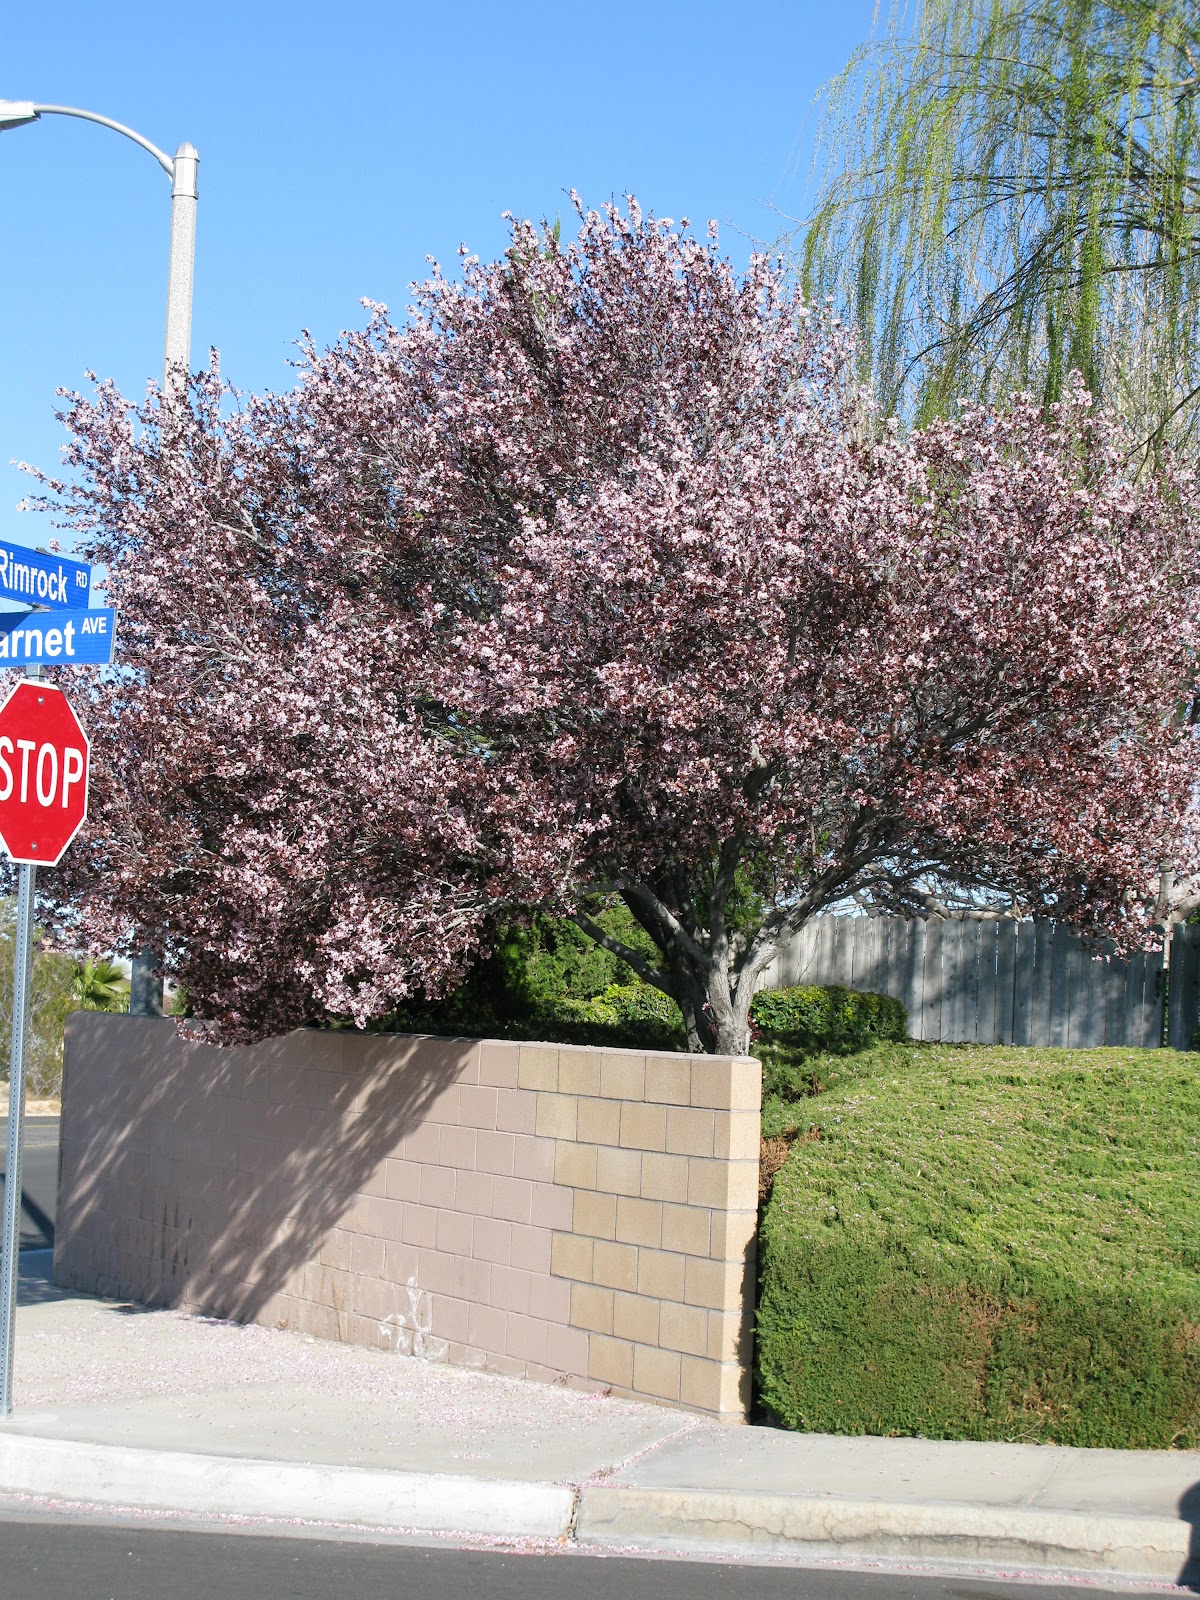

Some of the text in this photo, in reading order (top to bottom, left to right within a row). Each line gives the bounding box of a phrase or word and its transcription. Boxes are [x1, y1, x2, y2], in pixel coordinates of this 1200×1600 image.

[0, 549, 88, 603] Rimrock RD
[81, 616, 107, 634] AVE
[0, 736, 83, 808] STOP
